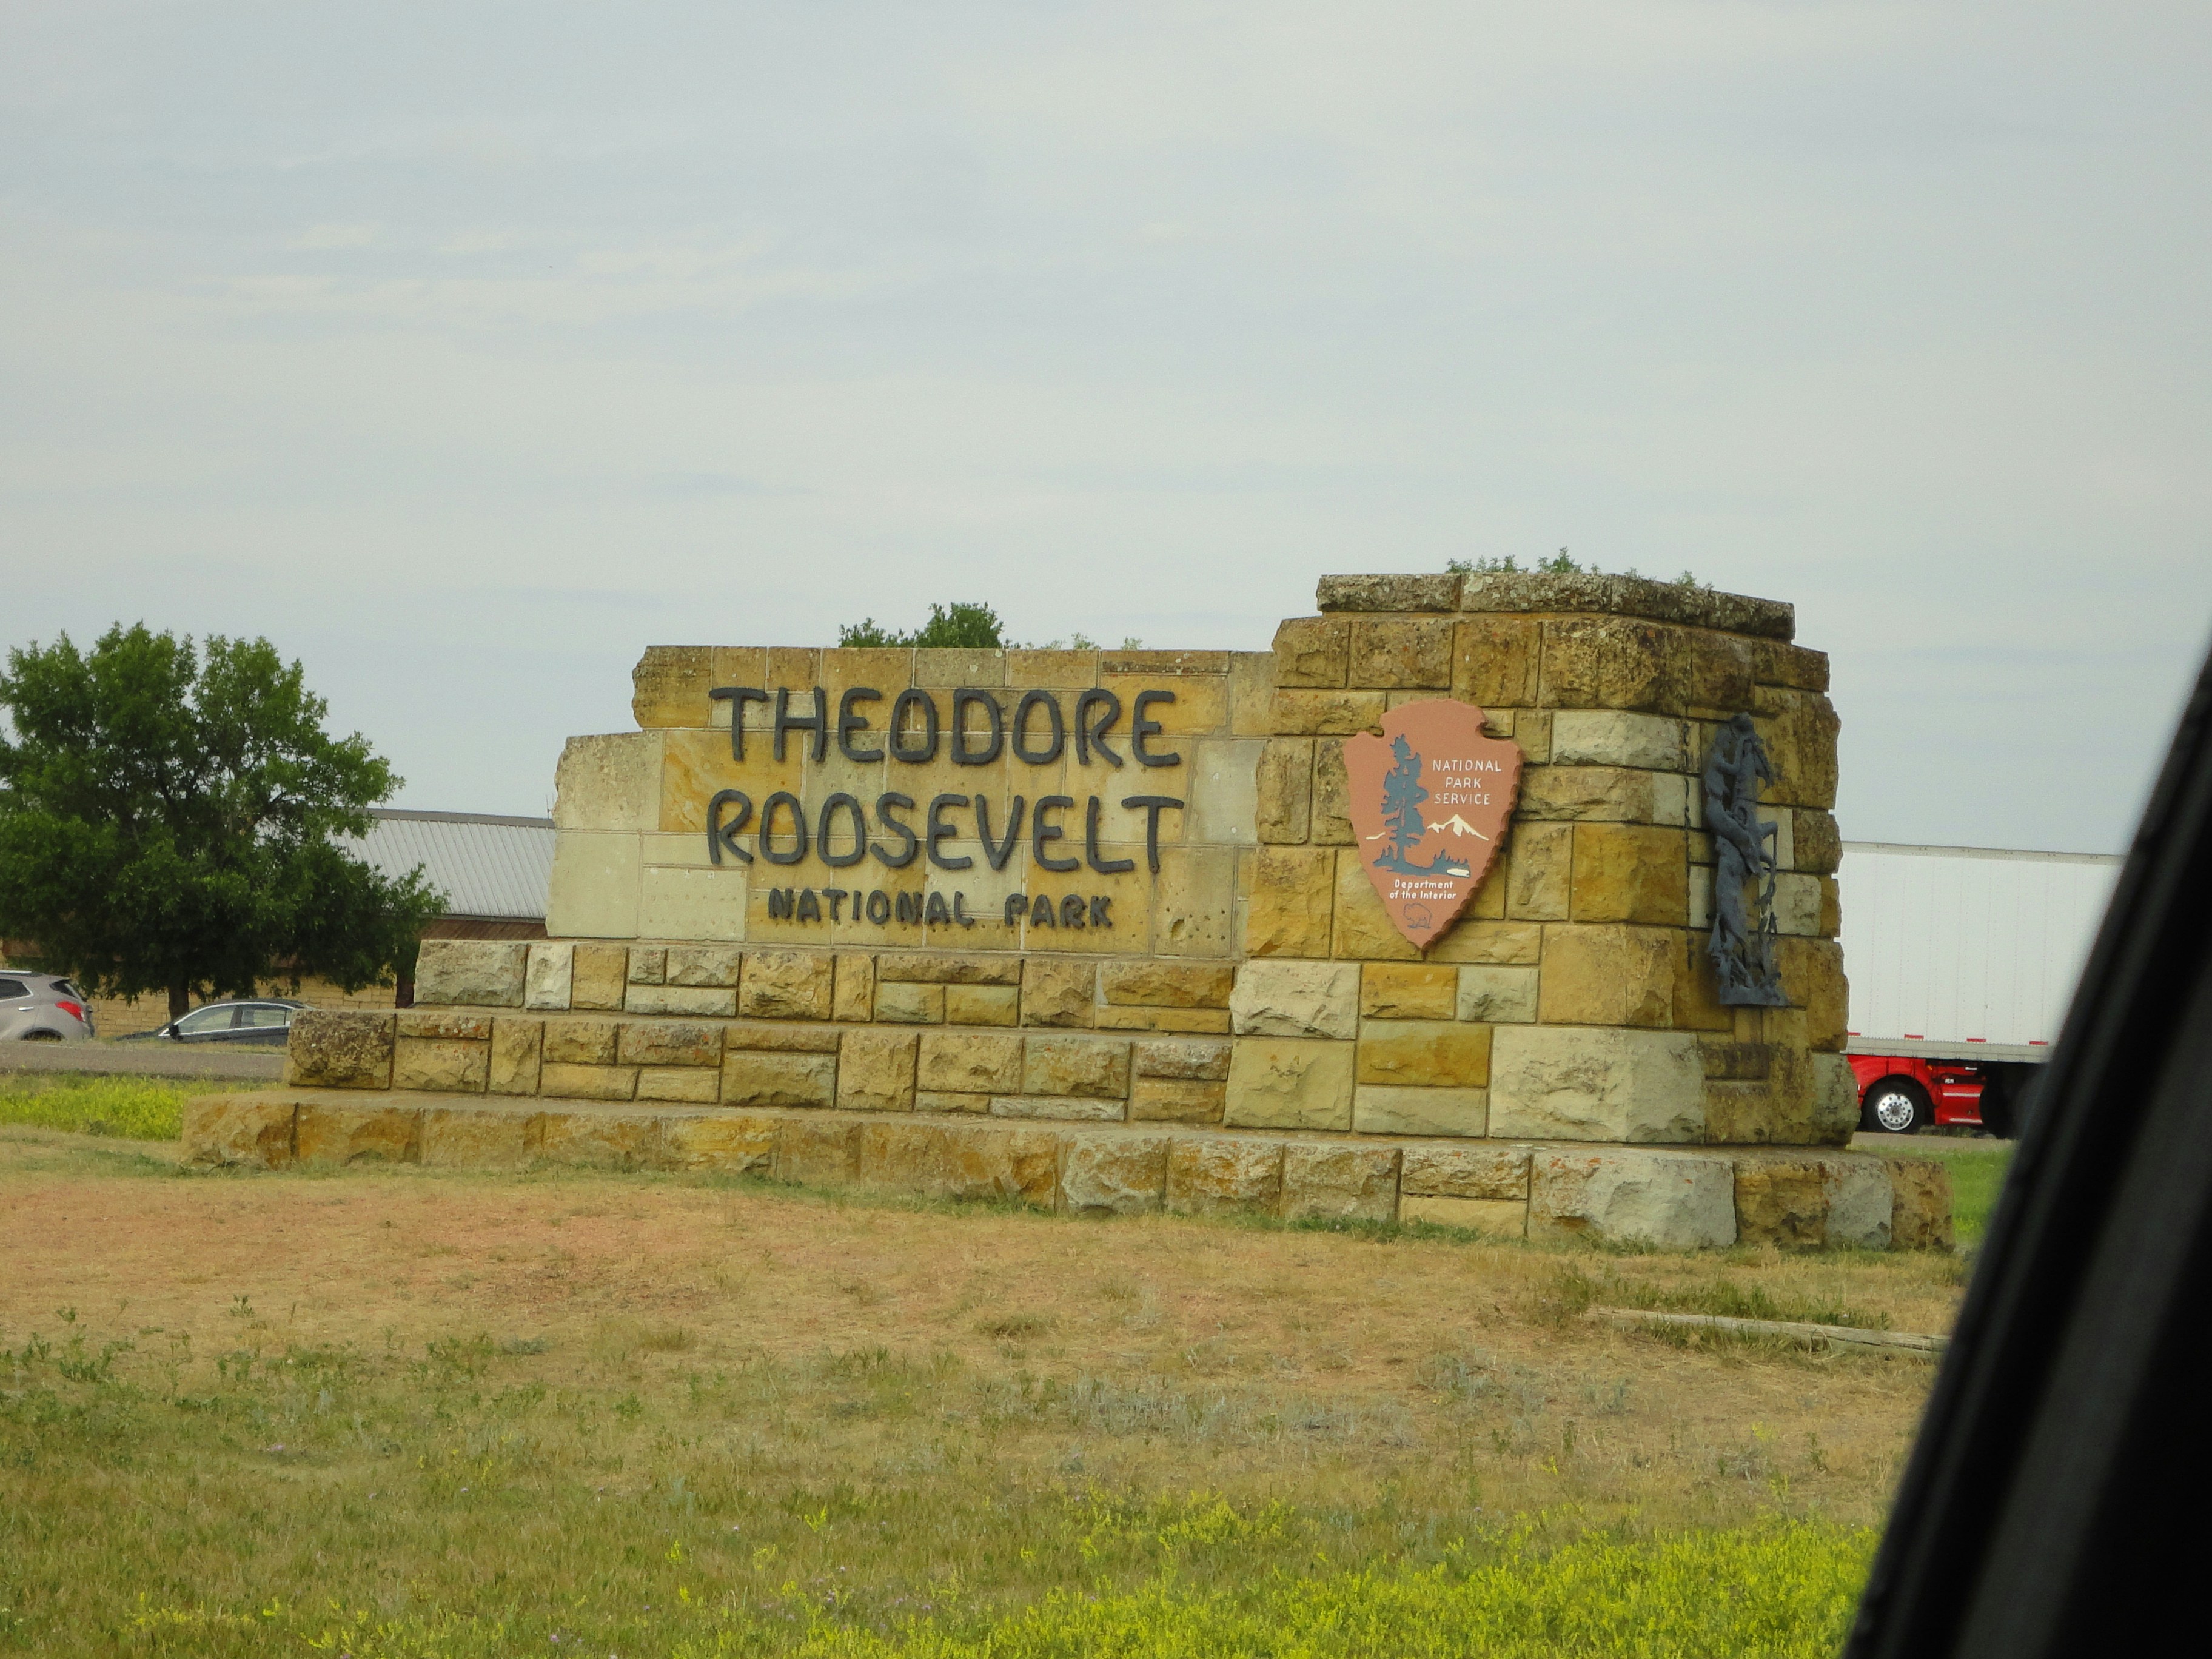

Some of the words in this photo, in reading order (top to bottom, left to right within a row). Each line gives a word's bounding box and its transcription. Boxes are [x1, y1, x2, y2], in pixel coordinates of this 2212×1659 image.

[710, 686, 1180, 767] THEODORE
[1432, 759, 1501, 772] NATIONAL
[1445, 776, 1481, 788] PARK
[1434, 793, 1490, 805] SERVICE
[707, 789, 1185, 874] ROOSEVELT
[1395, 879, 1453, 890] Department
[1389, 890, 1399, 899] of
[1401, 890, 1416, 899] the
[1420, 890, 1456, 899] Interior
[768, 888, 974, 925] NATIONAL
[1005, 894, 1112, 927] PARK
